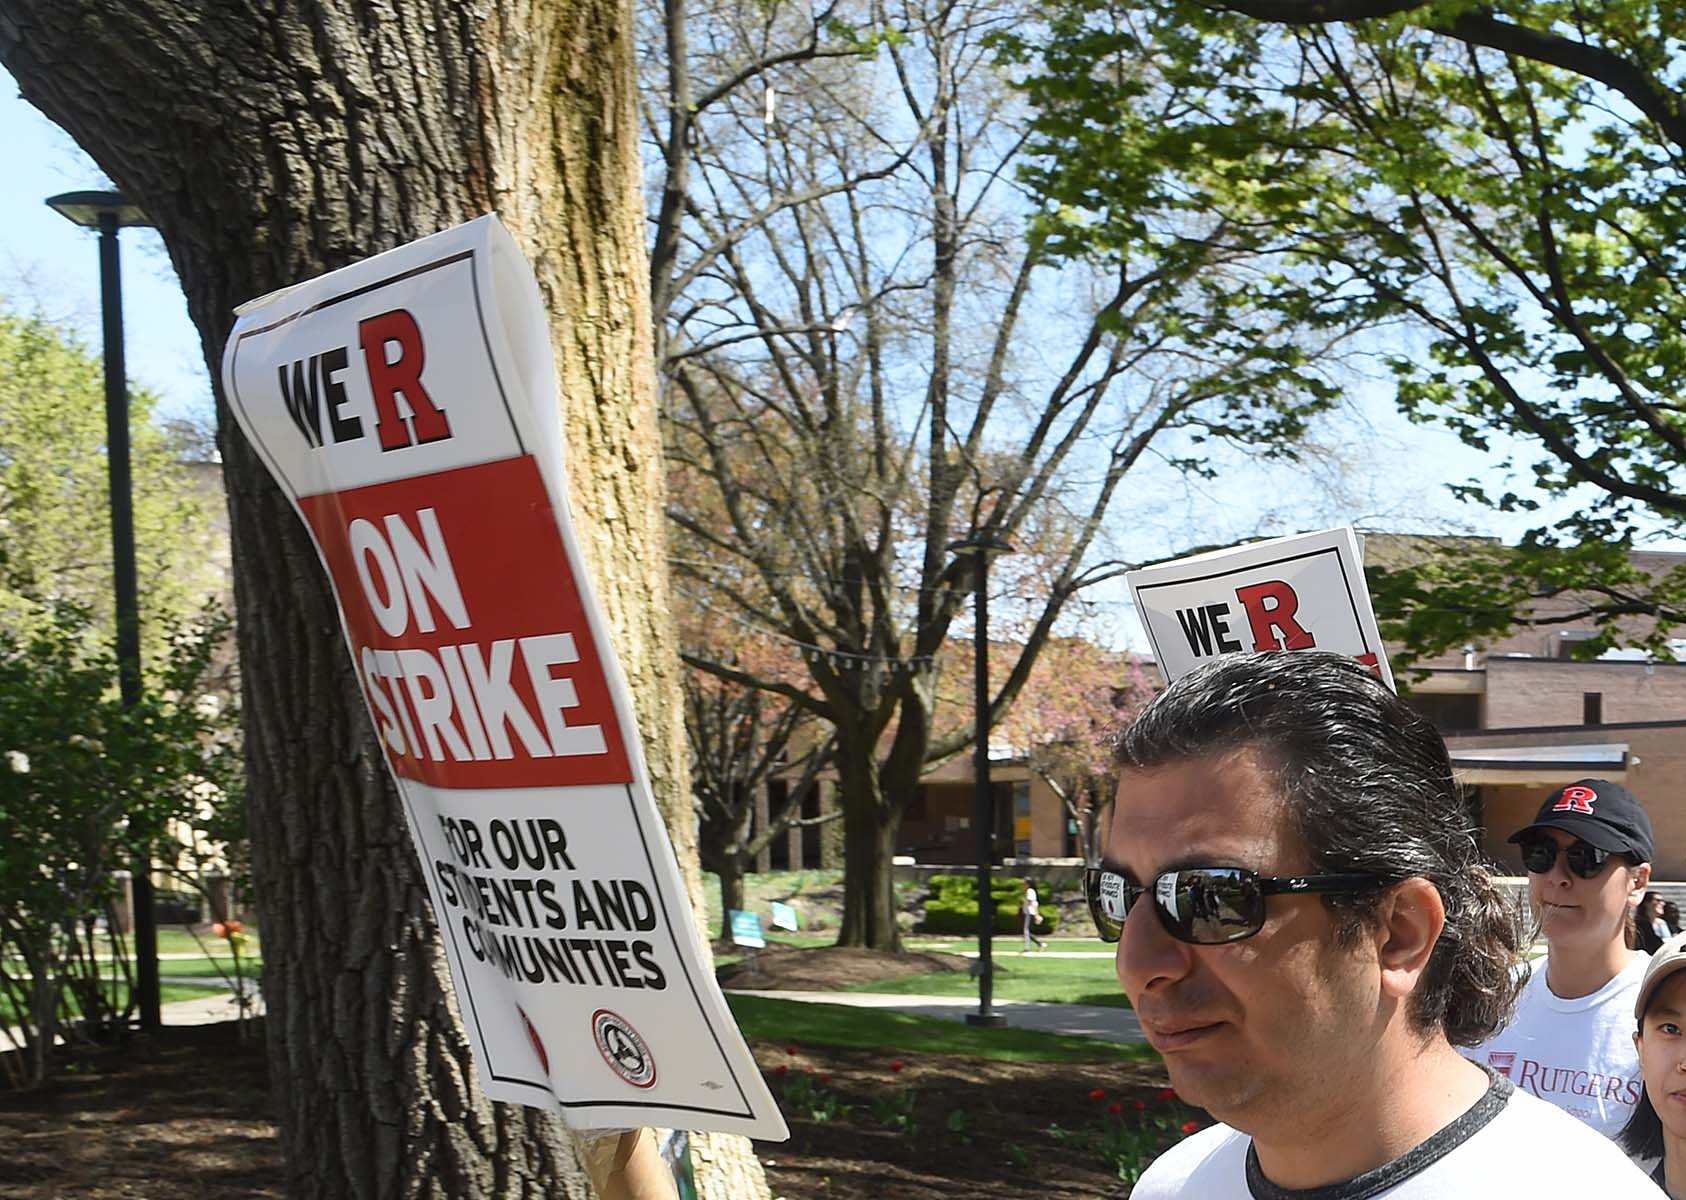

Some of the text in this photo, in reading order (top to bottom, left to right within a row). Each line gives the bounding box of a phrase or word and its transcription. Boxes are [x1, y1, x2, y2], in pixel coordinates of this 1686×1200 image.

[278, 307, 455, 453] WE R
[348, 507, 472, 638] ON
[1175, 579, 1317, 658] WE R
[361, 631, 609, 762] STRIKE
[1551, 785, 1599, 816] R
[489, 818, 577, 872] OUR
[571, 879, 658, 932] AND
